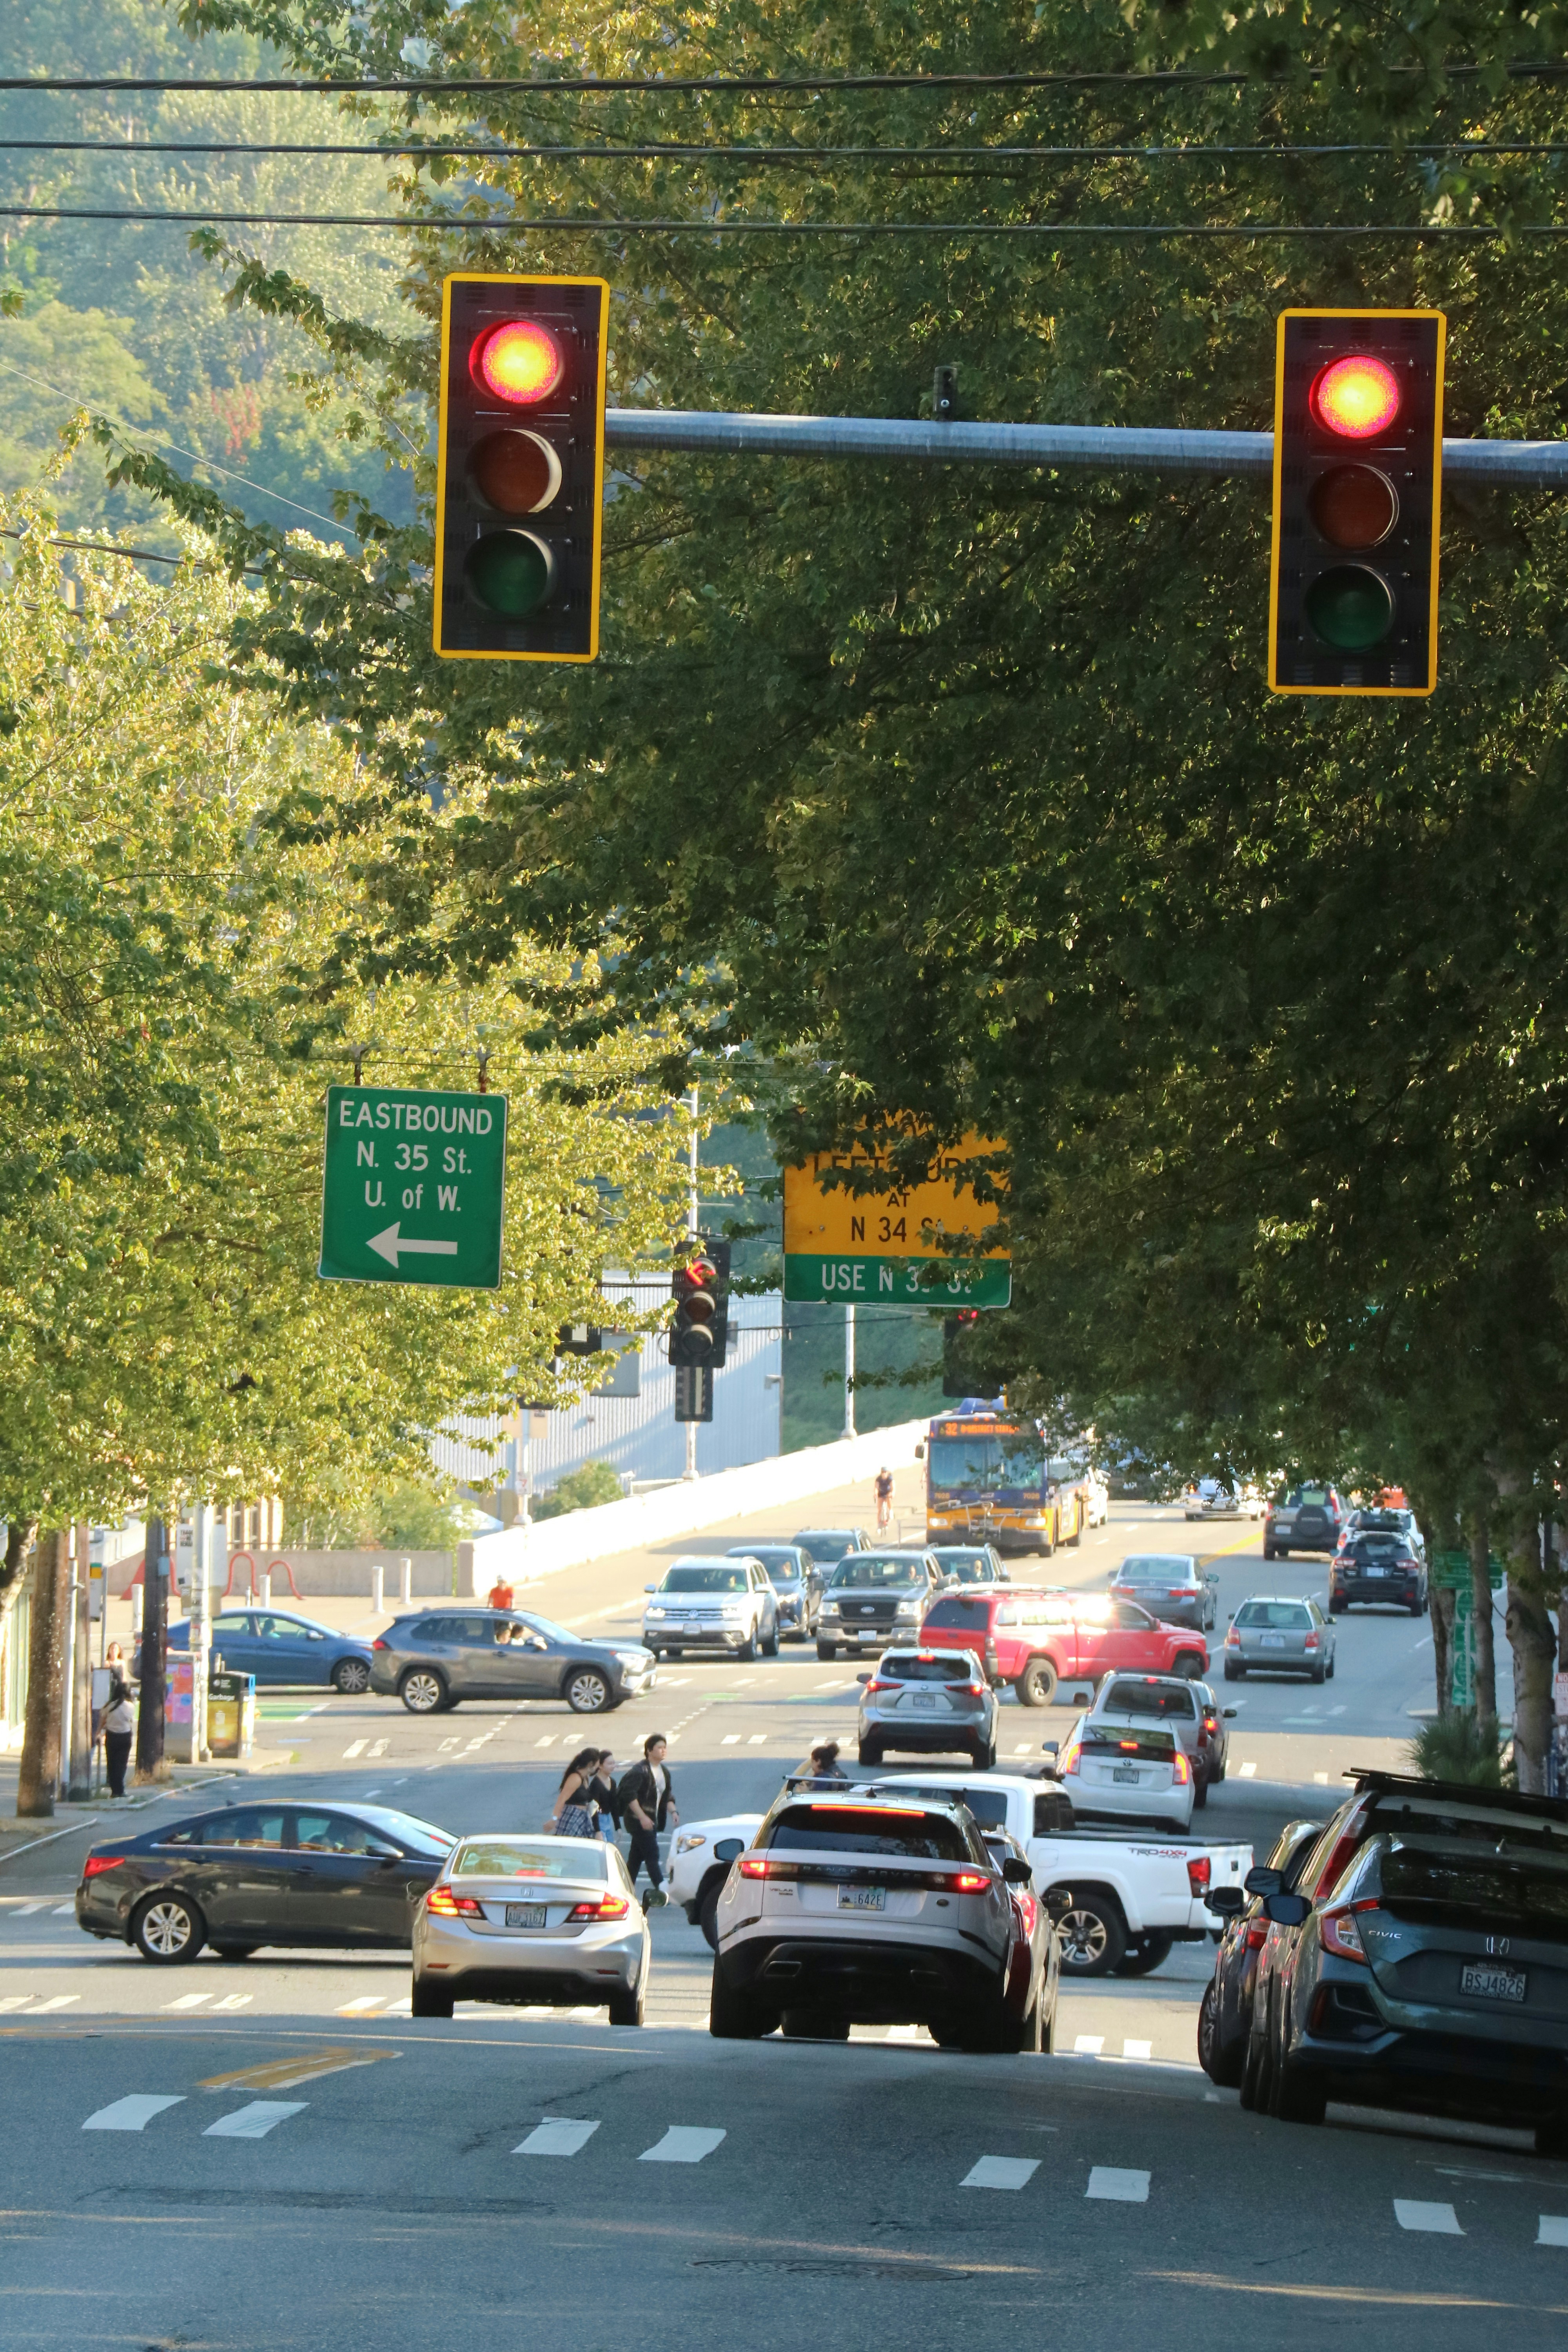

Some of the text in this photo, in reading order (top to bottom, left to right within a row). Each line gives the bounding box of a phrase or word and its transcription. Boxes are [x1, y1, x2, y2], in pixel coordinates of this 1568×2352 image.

[339, 1100, 492, 1134] EASTBOUND
[357, 1140, 472, 1174] N. 35 St.
[365, 1181, 461, 1211] U. of W.
[887, 1192, 911, 1207] AT
[851, 1216, 865, 1241] N
[878, 1216, 907, 1242] 34
[822, 1264, 866, 1290] USE
[879, 1265, 893, 1292] N
[906, 1266, 930, 1293] 3
[945, 1422, 957, 1436] 32
[1128, 1847, 1158, 1856] TRD
[868, 1870, 922, 1878] ROVER
[1368, 1930, 1402, 1939] CIVIC
[1465, 1972, 1524, 1996] BSJ4826
